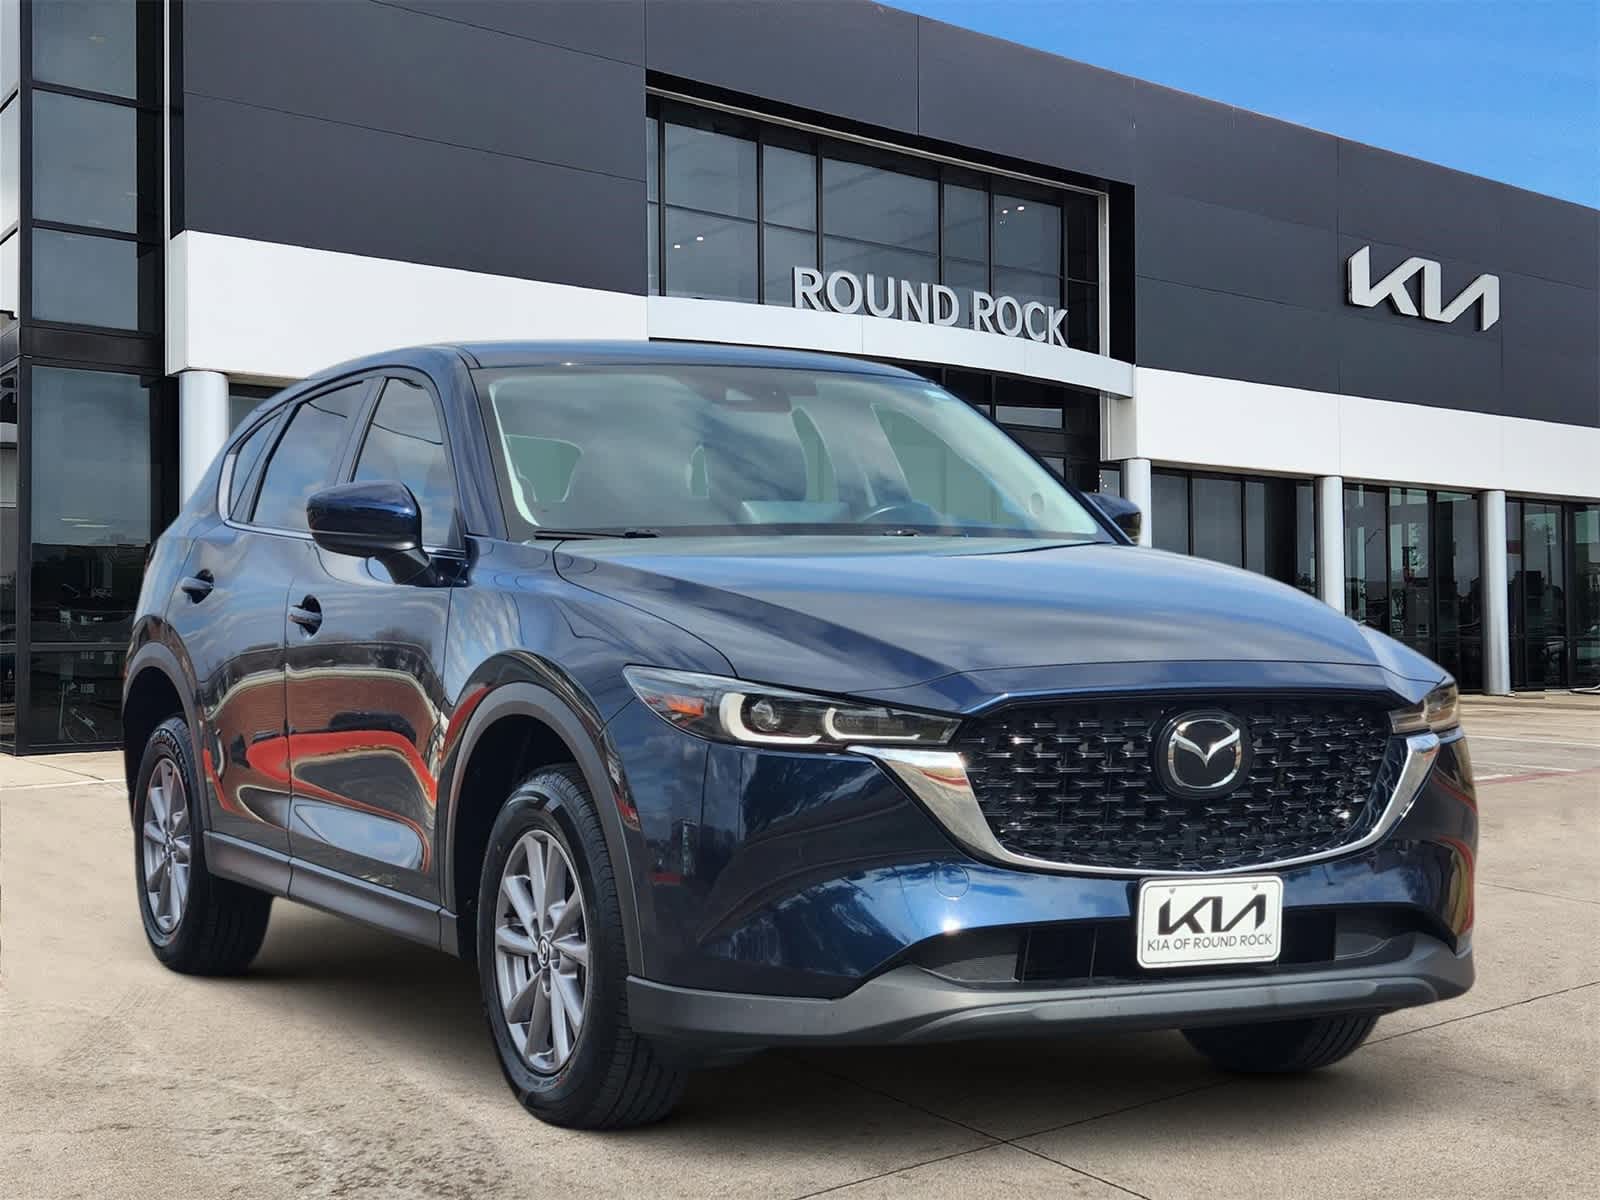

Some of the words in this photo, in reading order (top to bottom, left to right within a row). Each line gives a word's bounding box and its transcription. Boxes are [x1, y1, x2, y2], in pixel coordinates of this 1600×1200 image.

[793, 266, 959, 326] ROUND
[972, 290, 1069, 347] ROCK
[1147, 939, 1169, 951] KIA
[1173, 937, 1190, 950] OF
[1193, 935, 1237, 948] ROUND
[1240, 933, 1272, 946] ROCK
